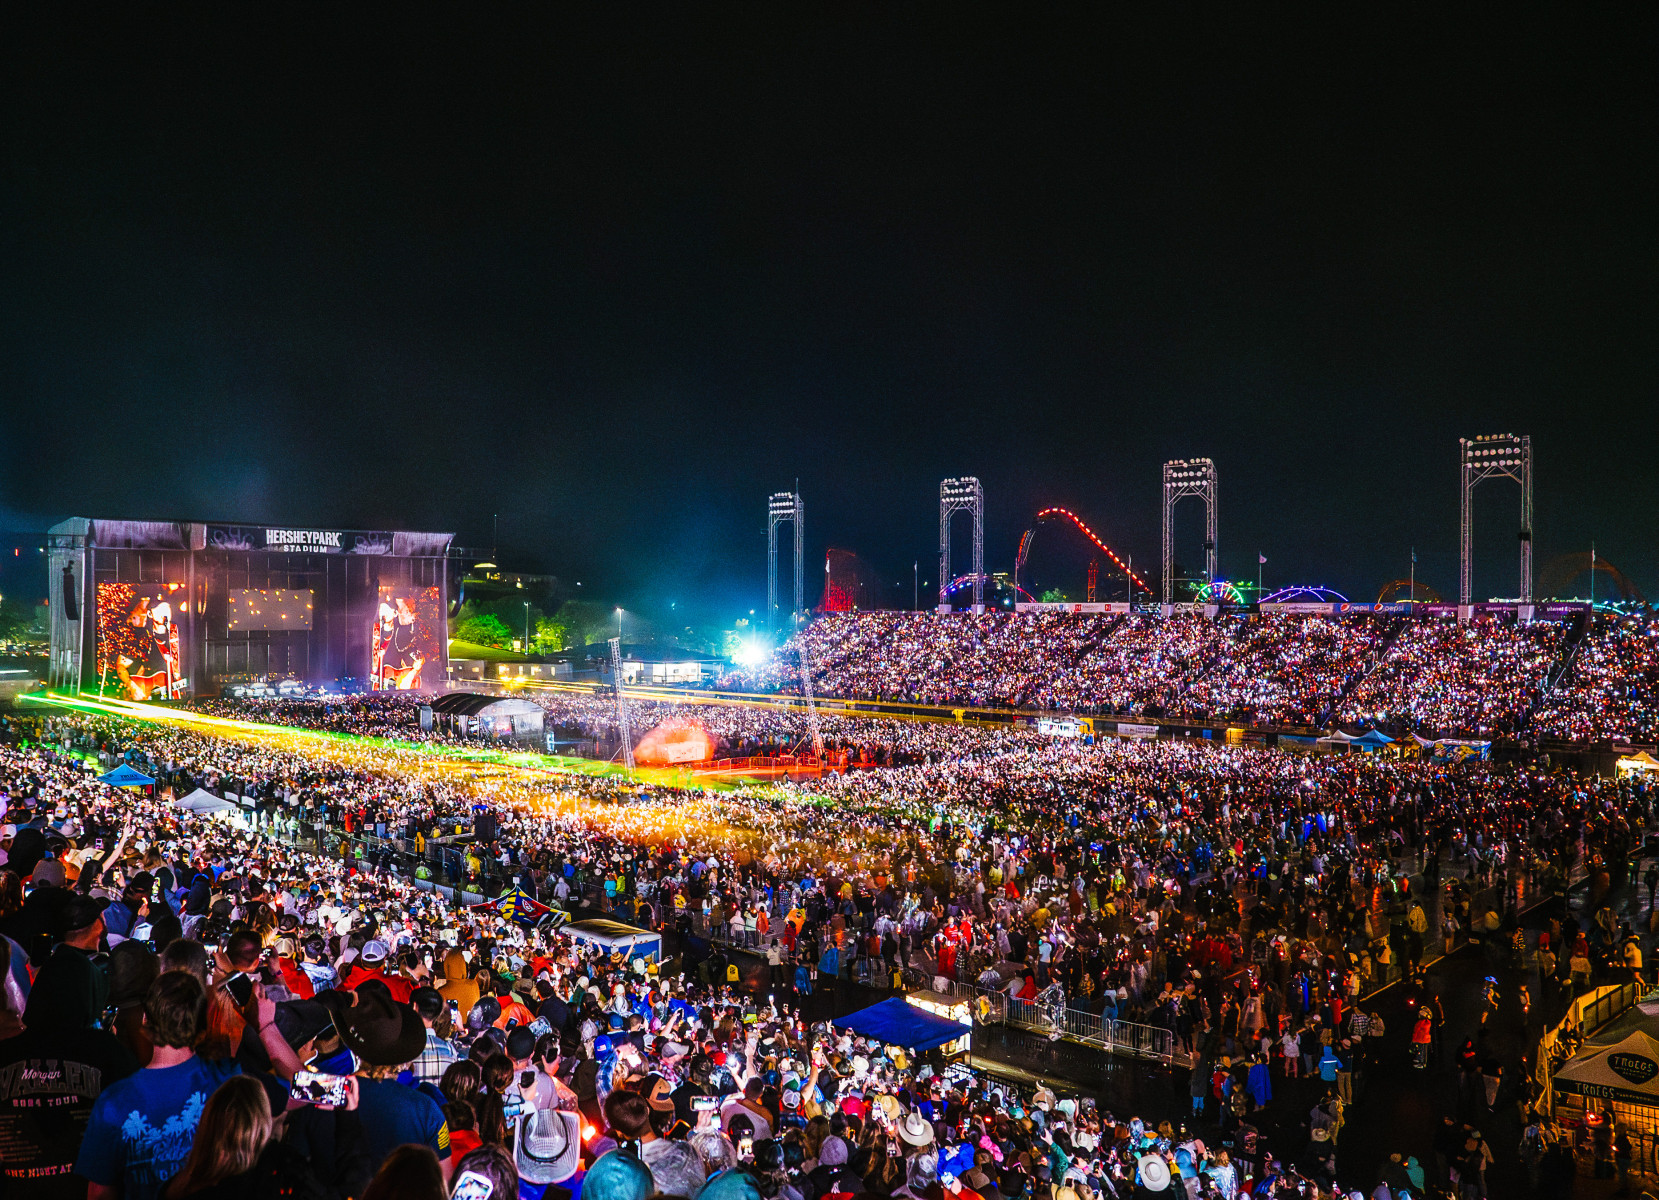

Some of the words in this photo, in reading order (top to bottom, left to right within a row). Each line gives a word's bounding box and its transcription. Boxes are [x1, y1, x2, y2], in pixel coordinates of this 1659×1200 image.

[265, 529, 340, 547] HERSHEYPARK
[283, 545, 327, 553] STADIUM
[1383, 604, 1404, 613] pepsi
[1614, 1056, 1654, 1073] TROEGS
[21, 1068, 62, 1084] Morgan
[1575, 1082, 1615, 1099] TROEGS
[47, 1095, 79, 1107] TOUR
[4, 1168, 25, 1178] ONE
[28, 1165, 58, 1178] NIGHT
[59, 1163, 73, 1174] AT
